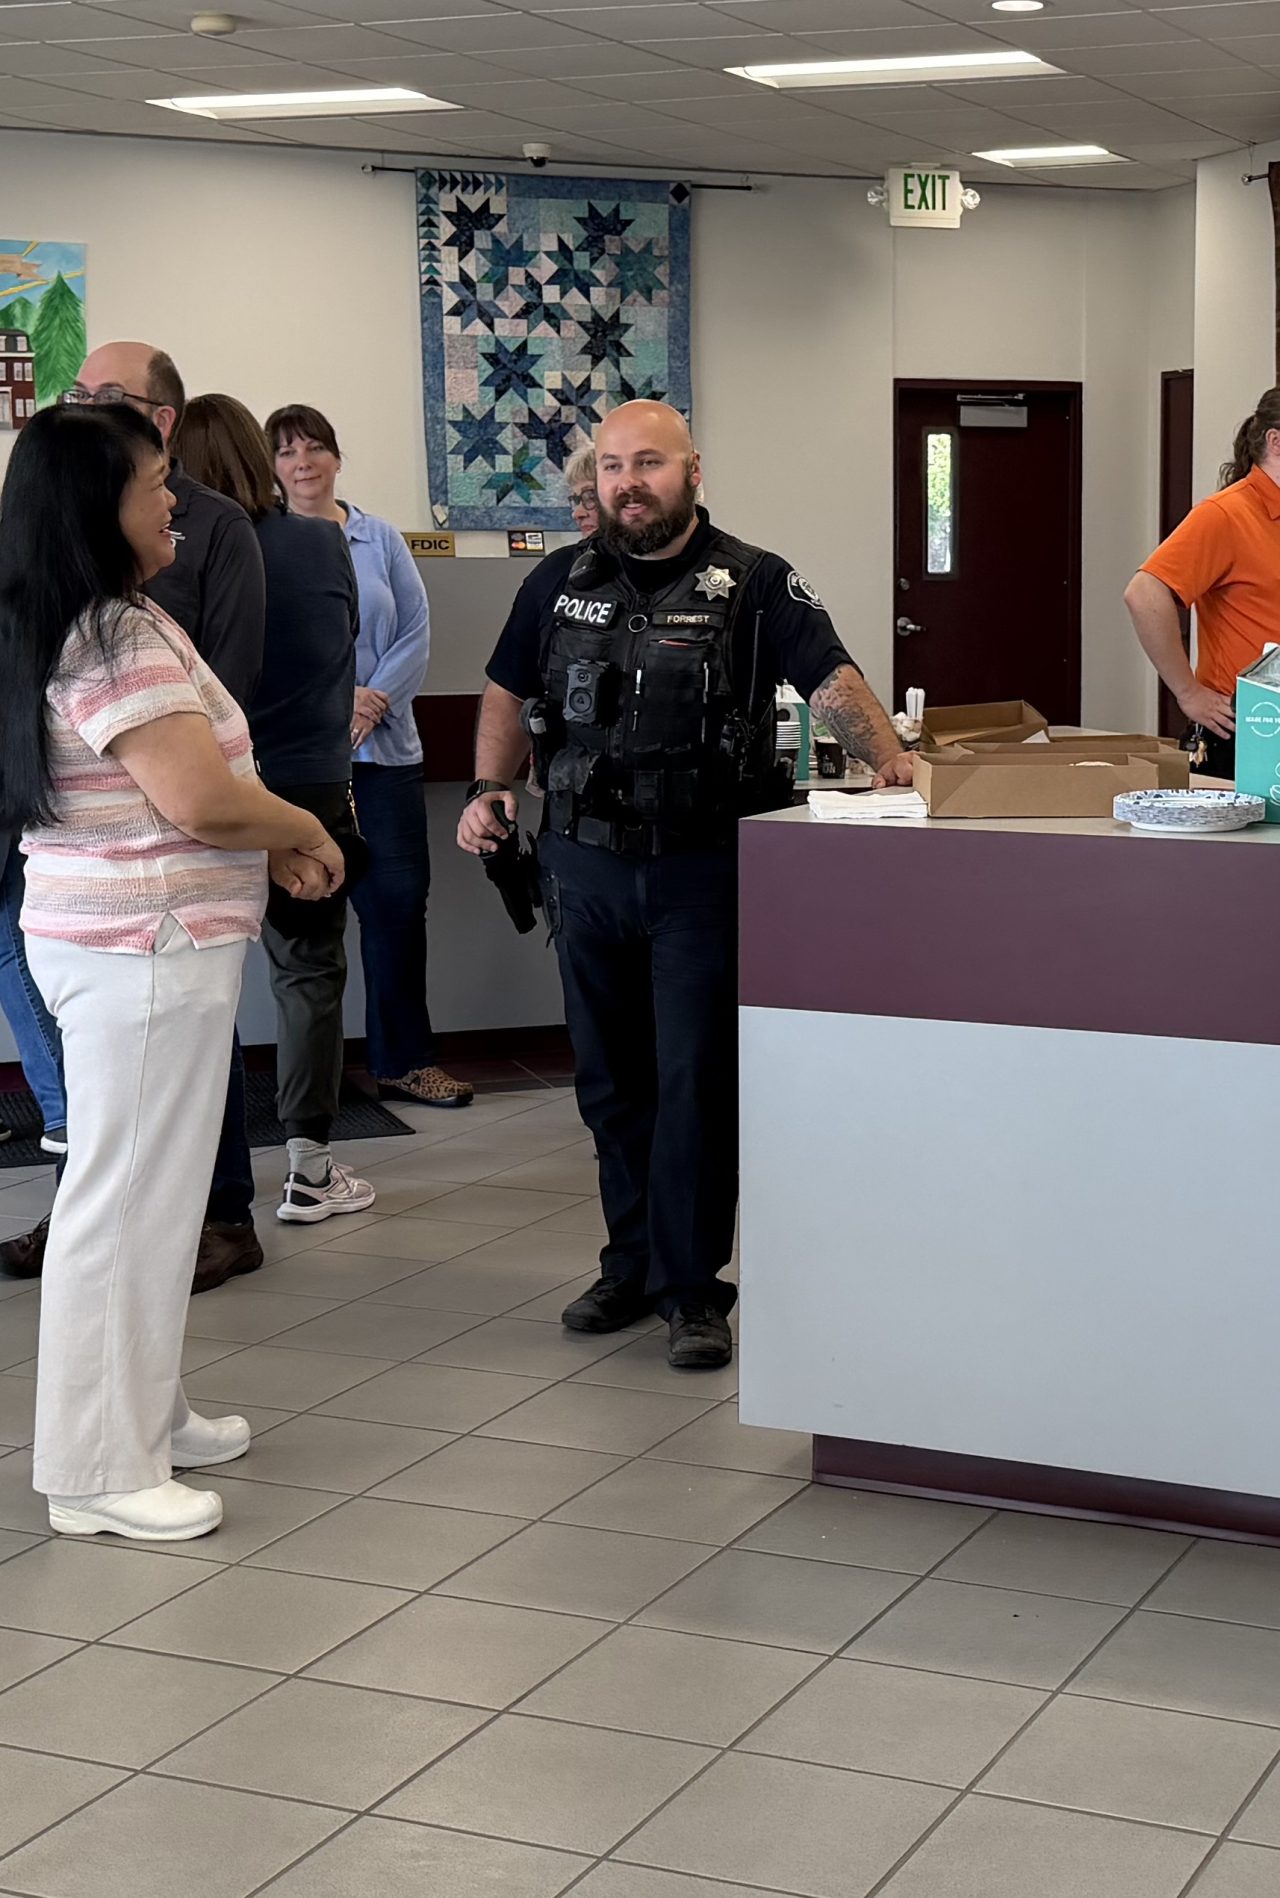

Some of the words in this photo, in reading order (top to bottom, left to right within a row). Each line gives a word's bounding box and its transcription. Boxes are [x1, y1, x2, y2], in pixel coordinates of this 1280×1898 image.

[903, 173, 950, 211] EXIT
[411, 539, 449, 550] FDIC
[553, 594, 611, 624] POLICE
[666, 615, 710, 624] FORREST
